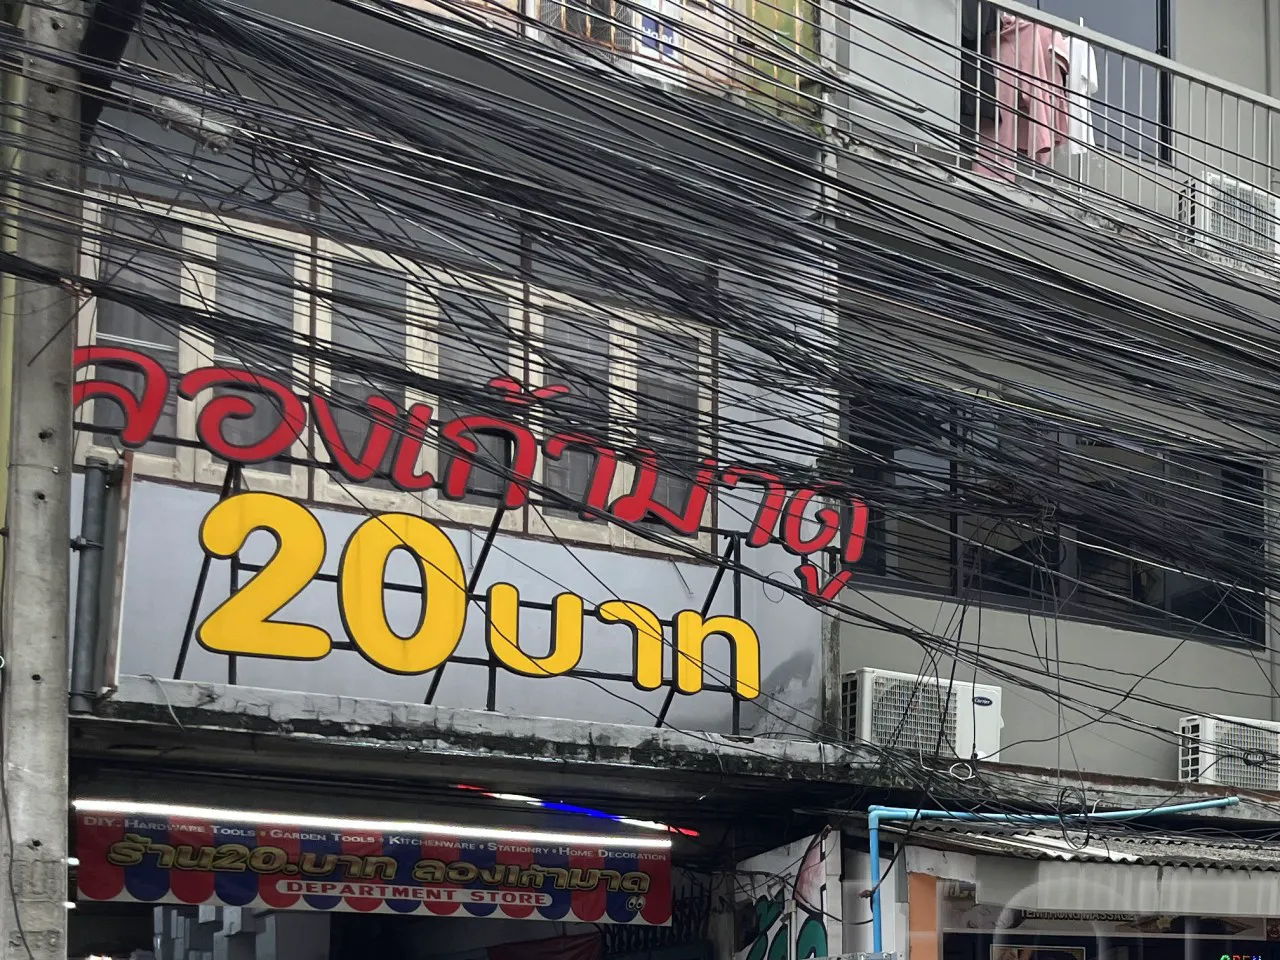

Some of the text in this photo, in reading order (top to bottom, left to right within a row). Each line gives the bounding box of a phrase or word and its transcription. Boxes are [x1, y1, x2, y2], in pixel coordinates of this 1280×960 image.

[197, 490, 762, 702] 20บาท
[270, 828, 327, 841] GARDEN
[330, 832, 375, 843] TOOLS
[388, 836, 476, 851] KITCHENWARE
[558, 847, 594, 858] HOME
[598, 849, 667, 862] DECORATION
[286, 881, 546, 905] DEPARTMENT STORE
